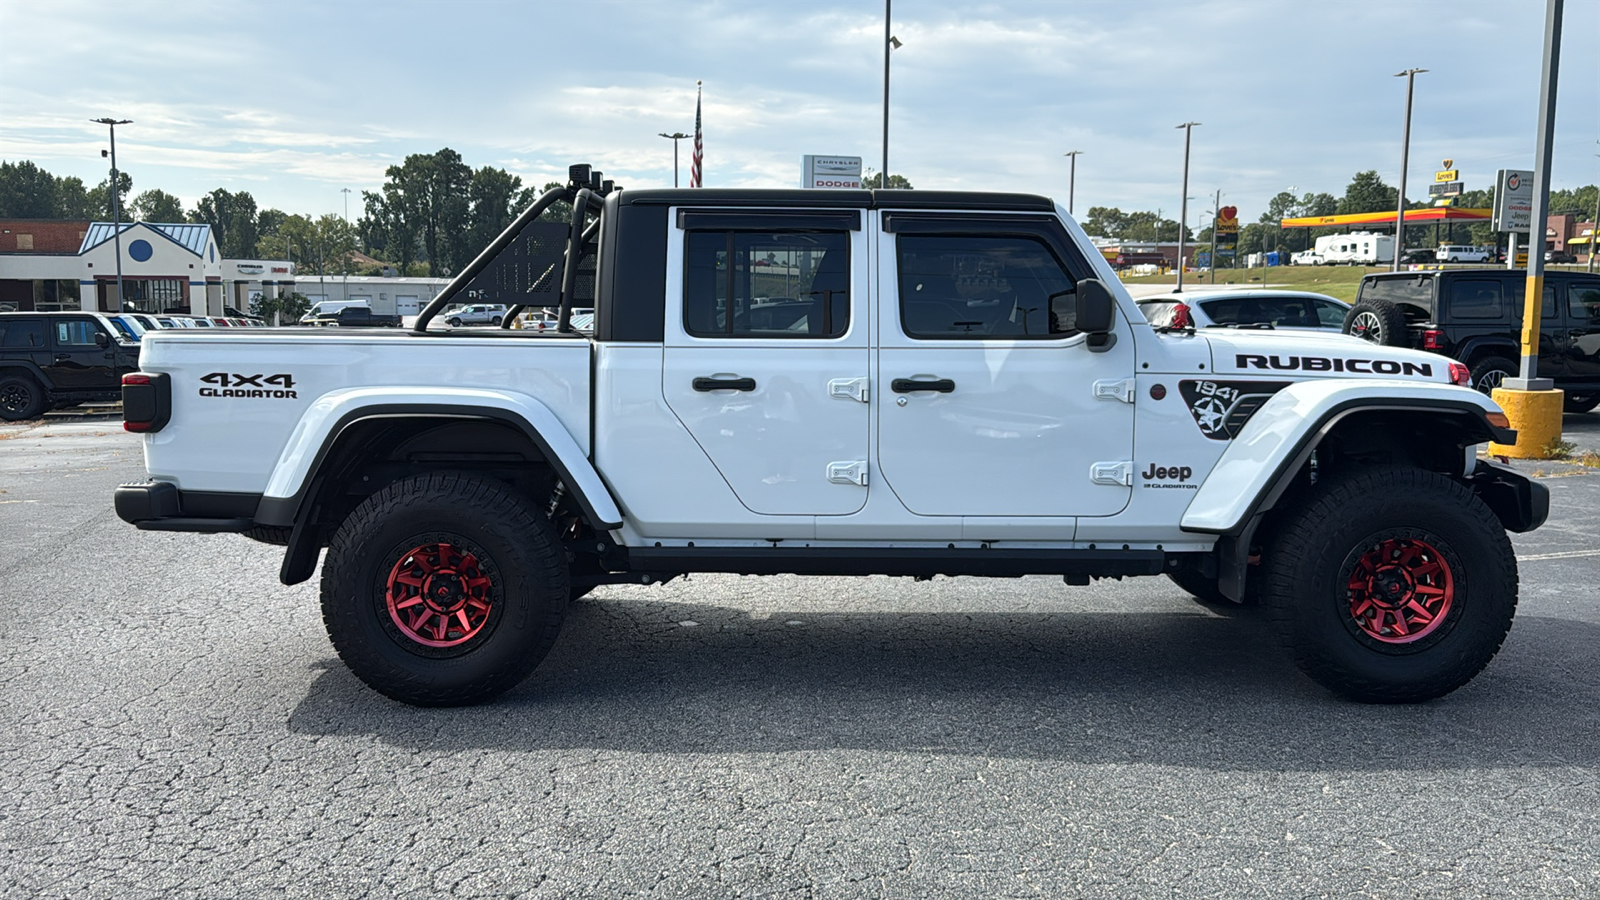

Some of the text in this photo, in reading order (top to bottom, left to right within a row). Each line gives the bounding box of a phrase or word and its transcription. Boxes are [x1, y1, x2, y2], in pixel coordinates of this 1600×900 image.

[1512, 212, 1529, 221] Jeep
[1236, 354, 1433, 377] RUBICON
[199, 387, 298, 399] GLADIATOR
[1195, 380, 1239, 402] 1941
[1142, 463, 1192, 482] Jeep
